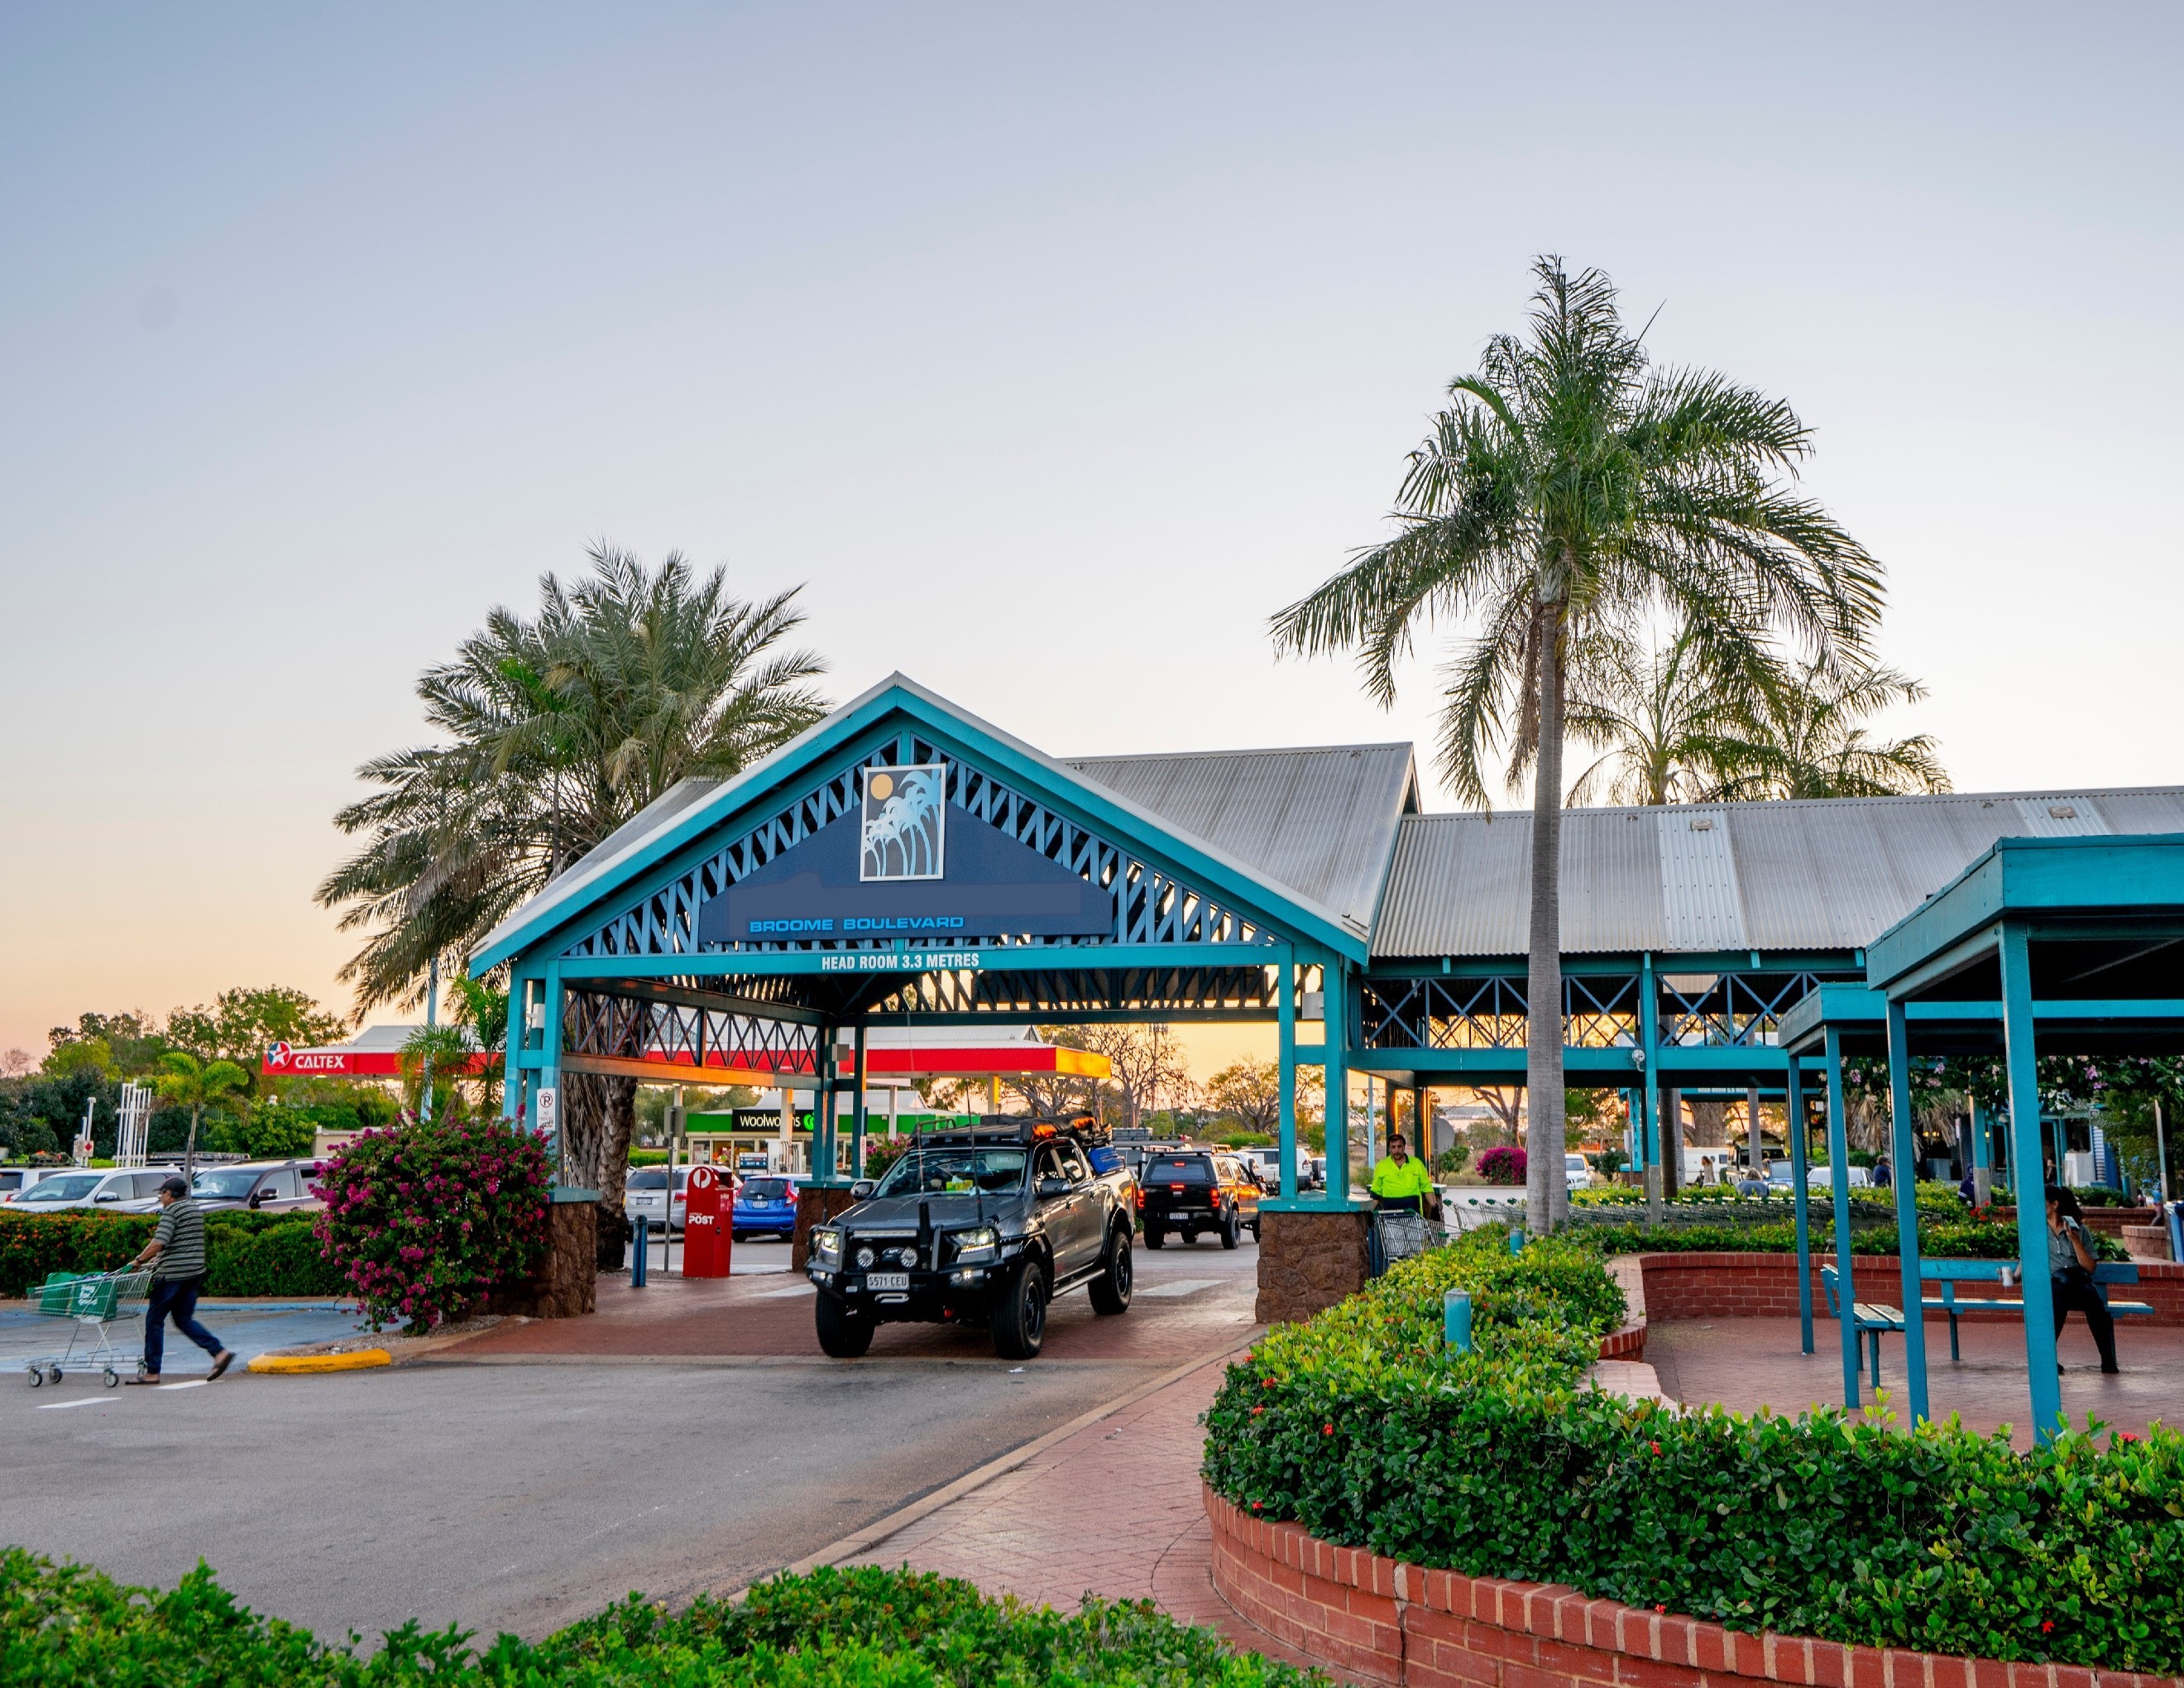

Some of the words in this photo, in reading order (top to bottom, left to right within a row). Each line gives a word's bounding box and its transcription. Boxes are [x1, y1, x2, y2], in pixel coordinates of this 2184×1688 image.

[750, 918, 834, 933] BROOME
[843, 917, 964, 931] BOULEVARD
[821, 957, 855, 971] HEAD
[860, 955, 898, 969] ROOM
[902, 954, 922, 968] 3.3
[926, 952, 979, 968] METRES
[295, 1055, 345, 1069] CALTEX
[688, 1215, 715, 1225] POST
